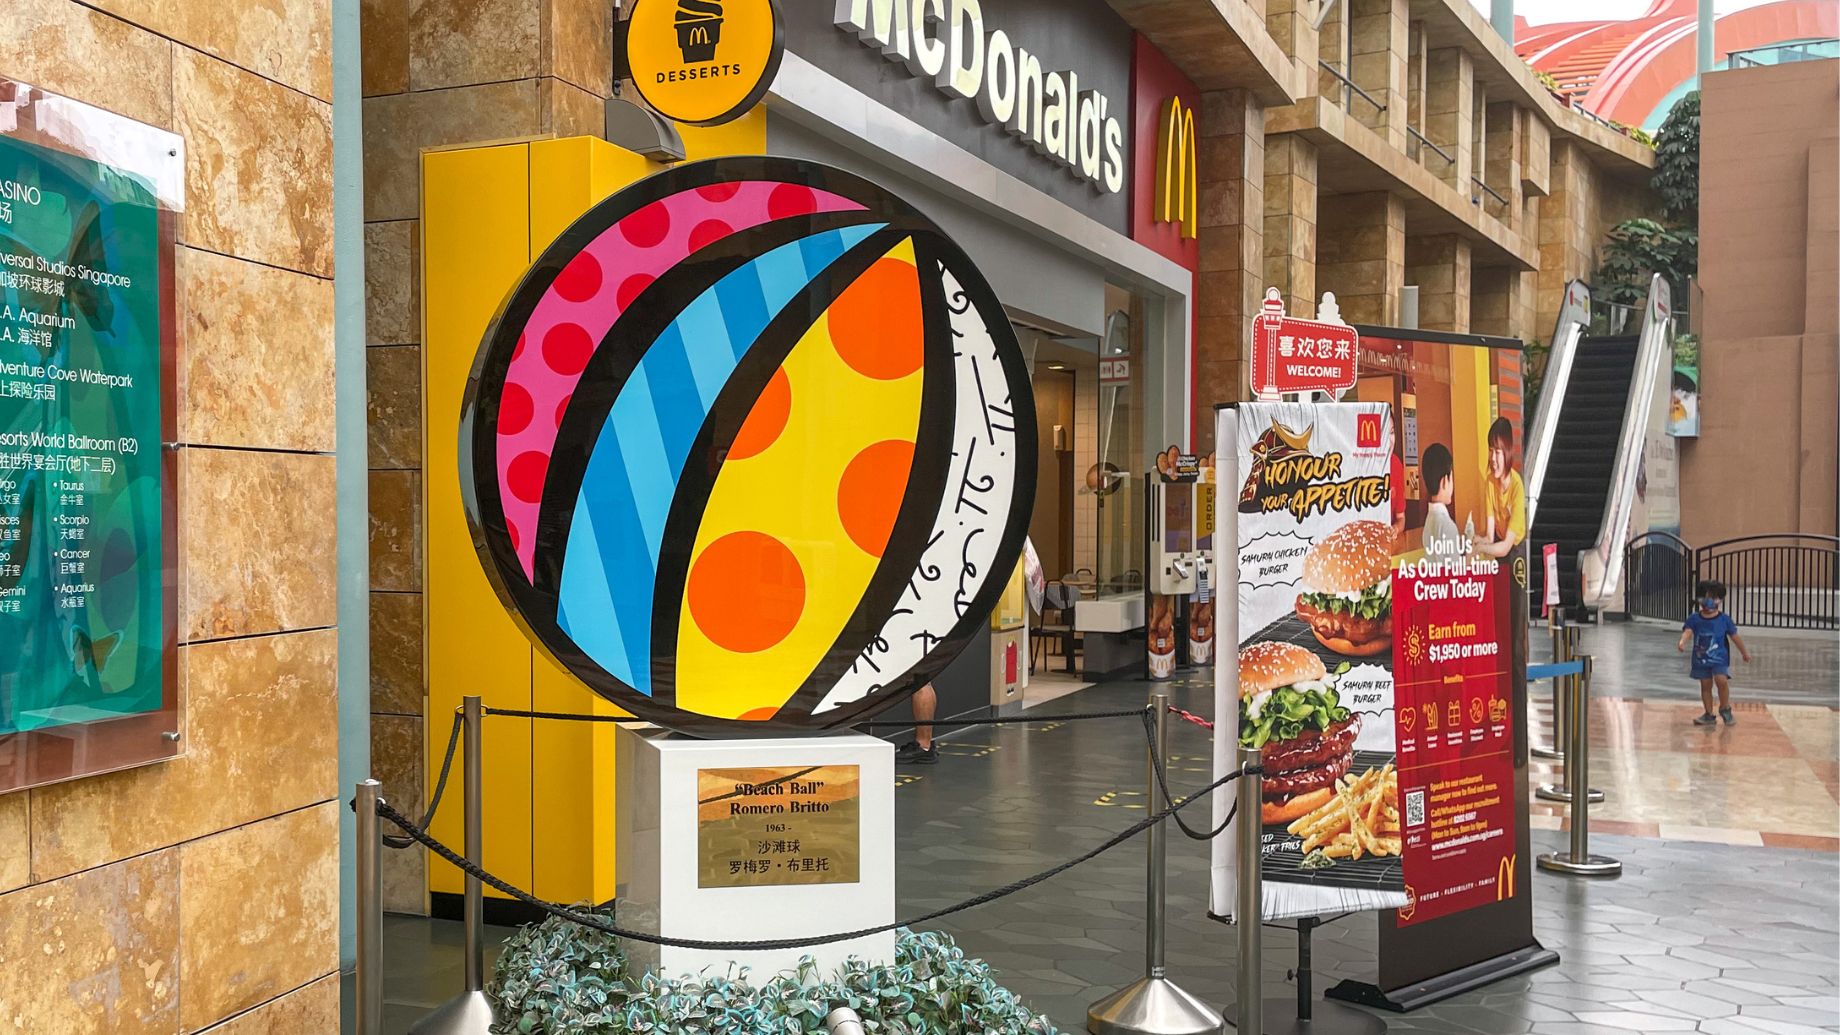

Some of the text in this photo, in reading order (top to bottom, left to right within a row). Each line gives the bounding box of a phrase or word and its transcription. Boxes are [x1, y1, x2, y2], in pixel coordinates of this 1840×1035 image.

[656, 63, 741, 84] DESSERTS
[36, 256, 76, 278] Studios
[78, 264, 131, 289] Singapore
[18, 307, 76, 330] Aquarium
[17, 327, 52, 348] 海洋馆
[1278, 335, 1351, 360] 喜欢您来
[0, 359, 133, 389] venture Cove Waterpark
[1286, 364, 1342, 378] WELCOME!
[30, 432, 65, 449] World
[68, 434, 116, 451] Ballroom
[118, 437, 138, 456] (B2)
[1265, 452, 1342, 489] HONOUR
[60, 480, 85, 491] Taurus
[60, 494, 84, 505] 金牛室
[1260, 473, 1390, 522] YOUR APPETITE!
[60, 514, 90, 526] Scorpio
[60, 548, 90, 559] Cancer
[1426, 534, 1473, 555] Join Us
[1240, 546, 1309, 566] SAMURAI CHICKEN
[1259, 563, 1289, 578] BURGER
[1398, 554, 1499, 579] As Our Full-time
[60, 582, 95, 595] Aquarius
[1414, 577, 1486, 603] Crew Today
[1428, 621, 1476, 640] Earn from
[1428, 641, 1498, 664] $1,950 or more
[1342, 680, 1392, 691] SAMURAI BEEF
[1352, 693, 1382, 705] BURGER
[730, 801, 830, 815] Romero Britto
[765, 824, 786, 833] 1963
[758, 840, 801, 854] 沙滩球
[1420, 891, 1439, 902] FUTURE
[1478, 876, 1496, 887] FAMILY
